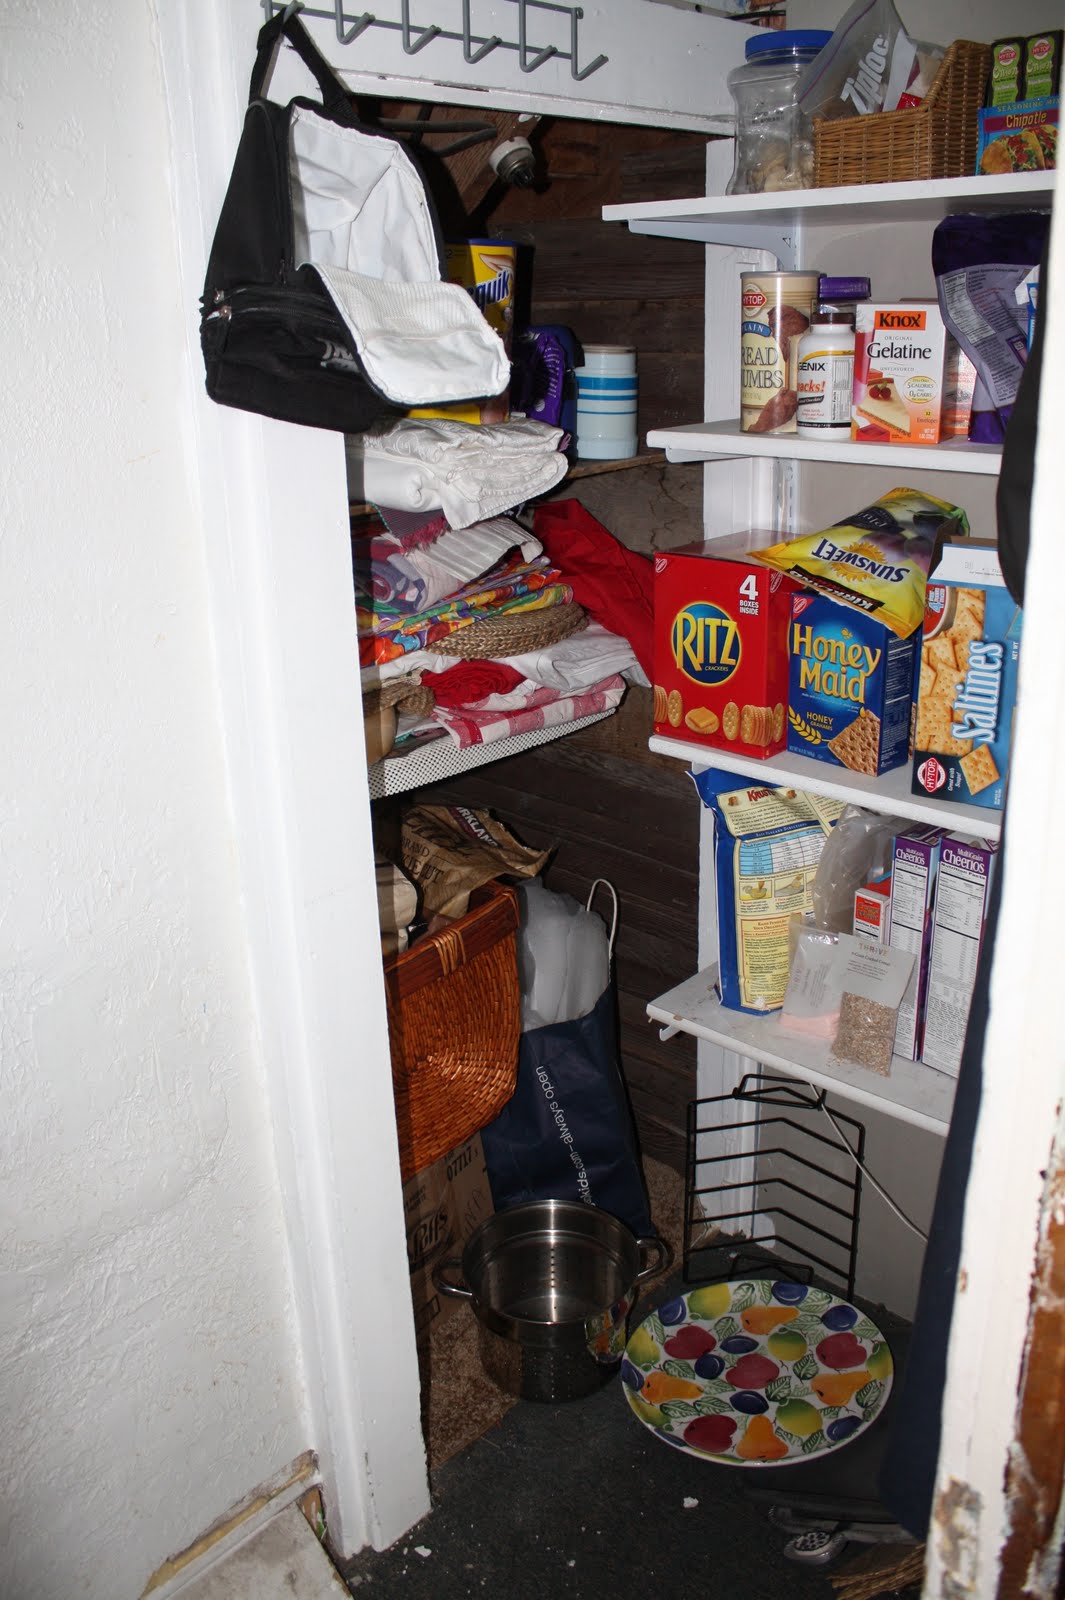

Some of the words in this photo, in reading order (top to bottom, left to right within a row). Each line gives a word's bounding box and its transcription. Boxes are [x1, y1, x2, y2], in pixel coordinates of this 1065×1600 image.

[840, 37, 889, 115] Ziploc
[1006, 111, 1047, 129] Chipotle
[879, 313, 921, 328] Knox
[867, 342, 932, 360] Gelatine
[811, 538, 911, 583] SUNSWEET
[739, 574, 759, 601] 4
[739, 600, 759, 609] BOXES
[739, 606, 759, 616] INSIDE
[676, 612, 738, 672] RITZ
[792, 623, 882, 678] Honey
[704, 665, 729, 673] CRACKERS
[799, 658, 867, 705] Maid
[951, 640, 1004, 744] Saltines
[806, 711, 834, 726] HONEY
[895, 848, 926, 866] Cheerios
[942, 849, 985, 874] Cheerios
[957, 848, 984, 862] MultiGrain
[859, 942, 889, 957] THRIVE
[535, 1065, 554, 1100] open
